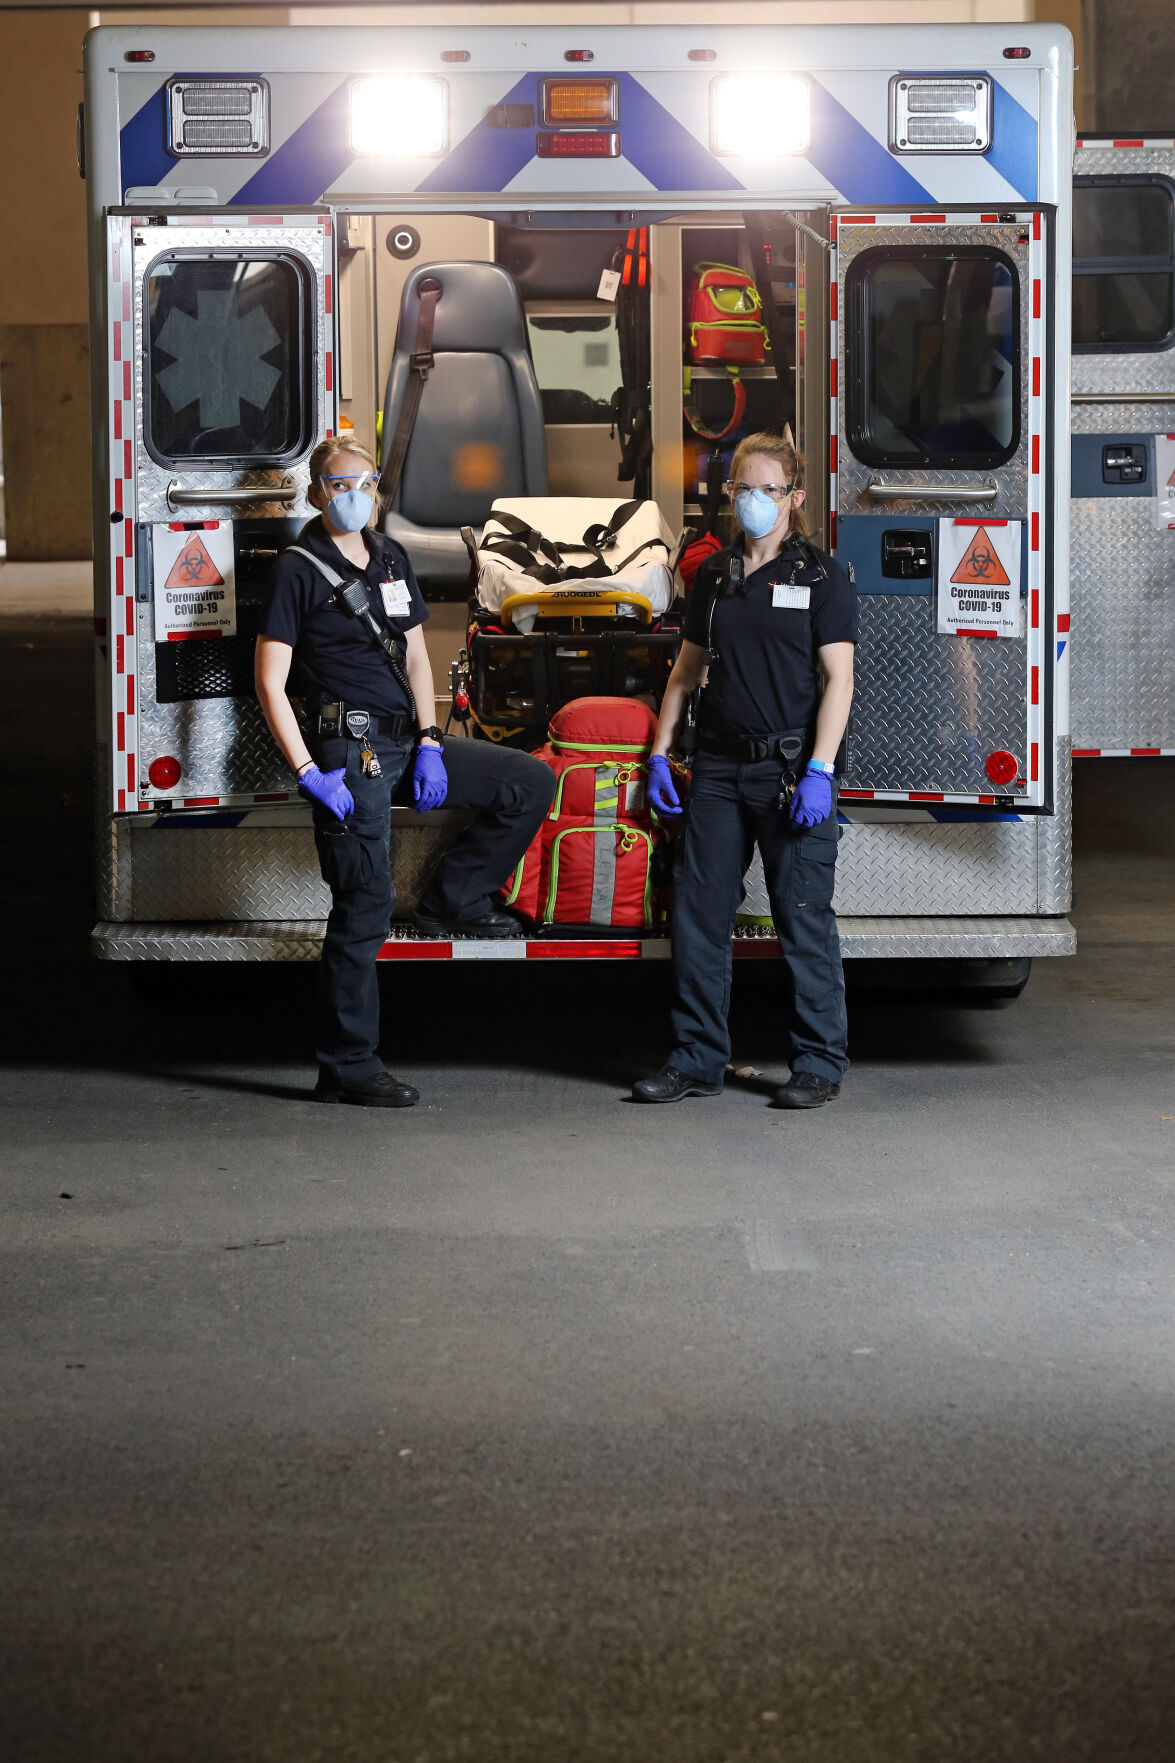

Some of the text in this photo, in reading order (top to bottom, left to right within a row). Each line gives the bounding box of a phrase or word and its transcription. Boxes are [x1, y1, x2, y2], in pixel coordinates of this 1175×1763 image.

[165, 590, 225, 603] Coronavirus
[951, 586, 1010, 600] Coronavirus
[174, 602, 218, 615] COVID-19
[958, 600, 1002, 612] COVID-19
[164, 618, 231, 629] Authorized Personnel Only
